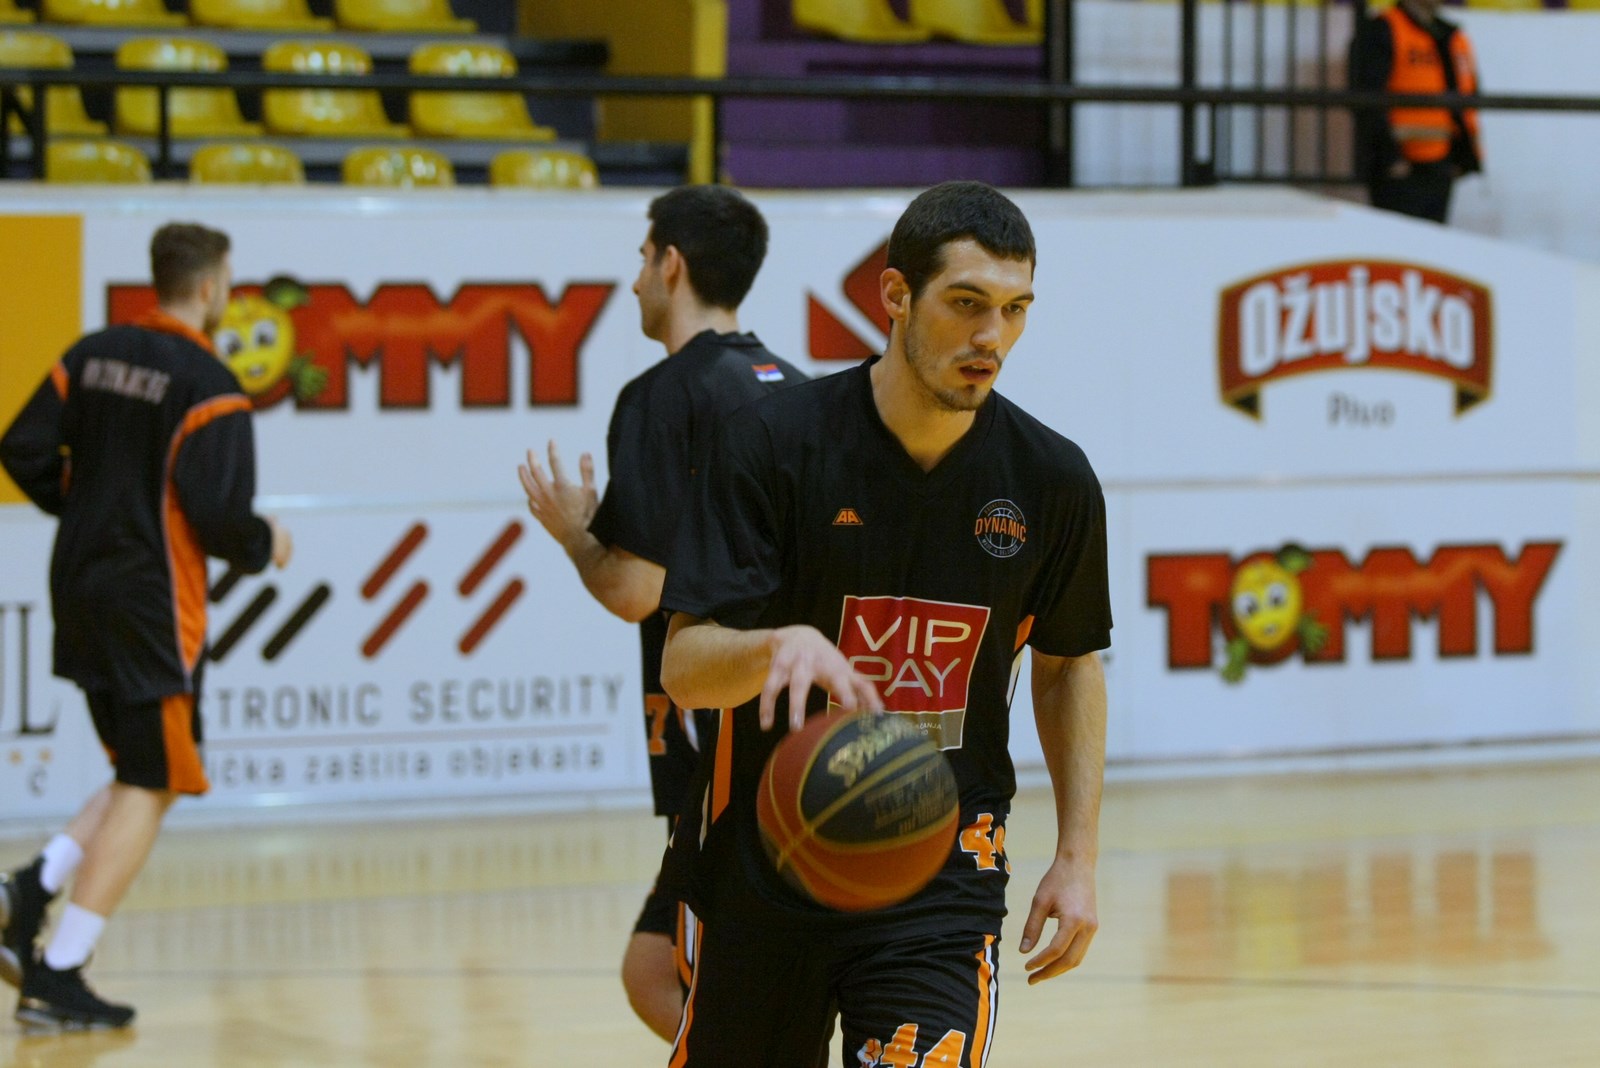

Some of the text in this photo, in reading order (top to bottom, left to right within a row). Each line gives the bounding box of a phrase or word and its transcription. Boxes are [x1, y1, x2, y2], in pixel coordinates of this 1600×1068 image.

[106, 281, 618, 412] MMY
[1238, 265, 1475, 377] Ožujsko
[975, 516, 1026, 543] DYNAMIC
[855, 614, 971, 656] VIP
[216, 673, 624, 730] TRONIC SECURITY
[880, 1023, 967, 1068] 44
